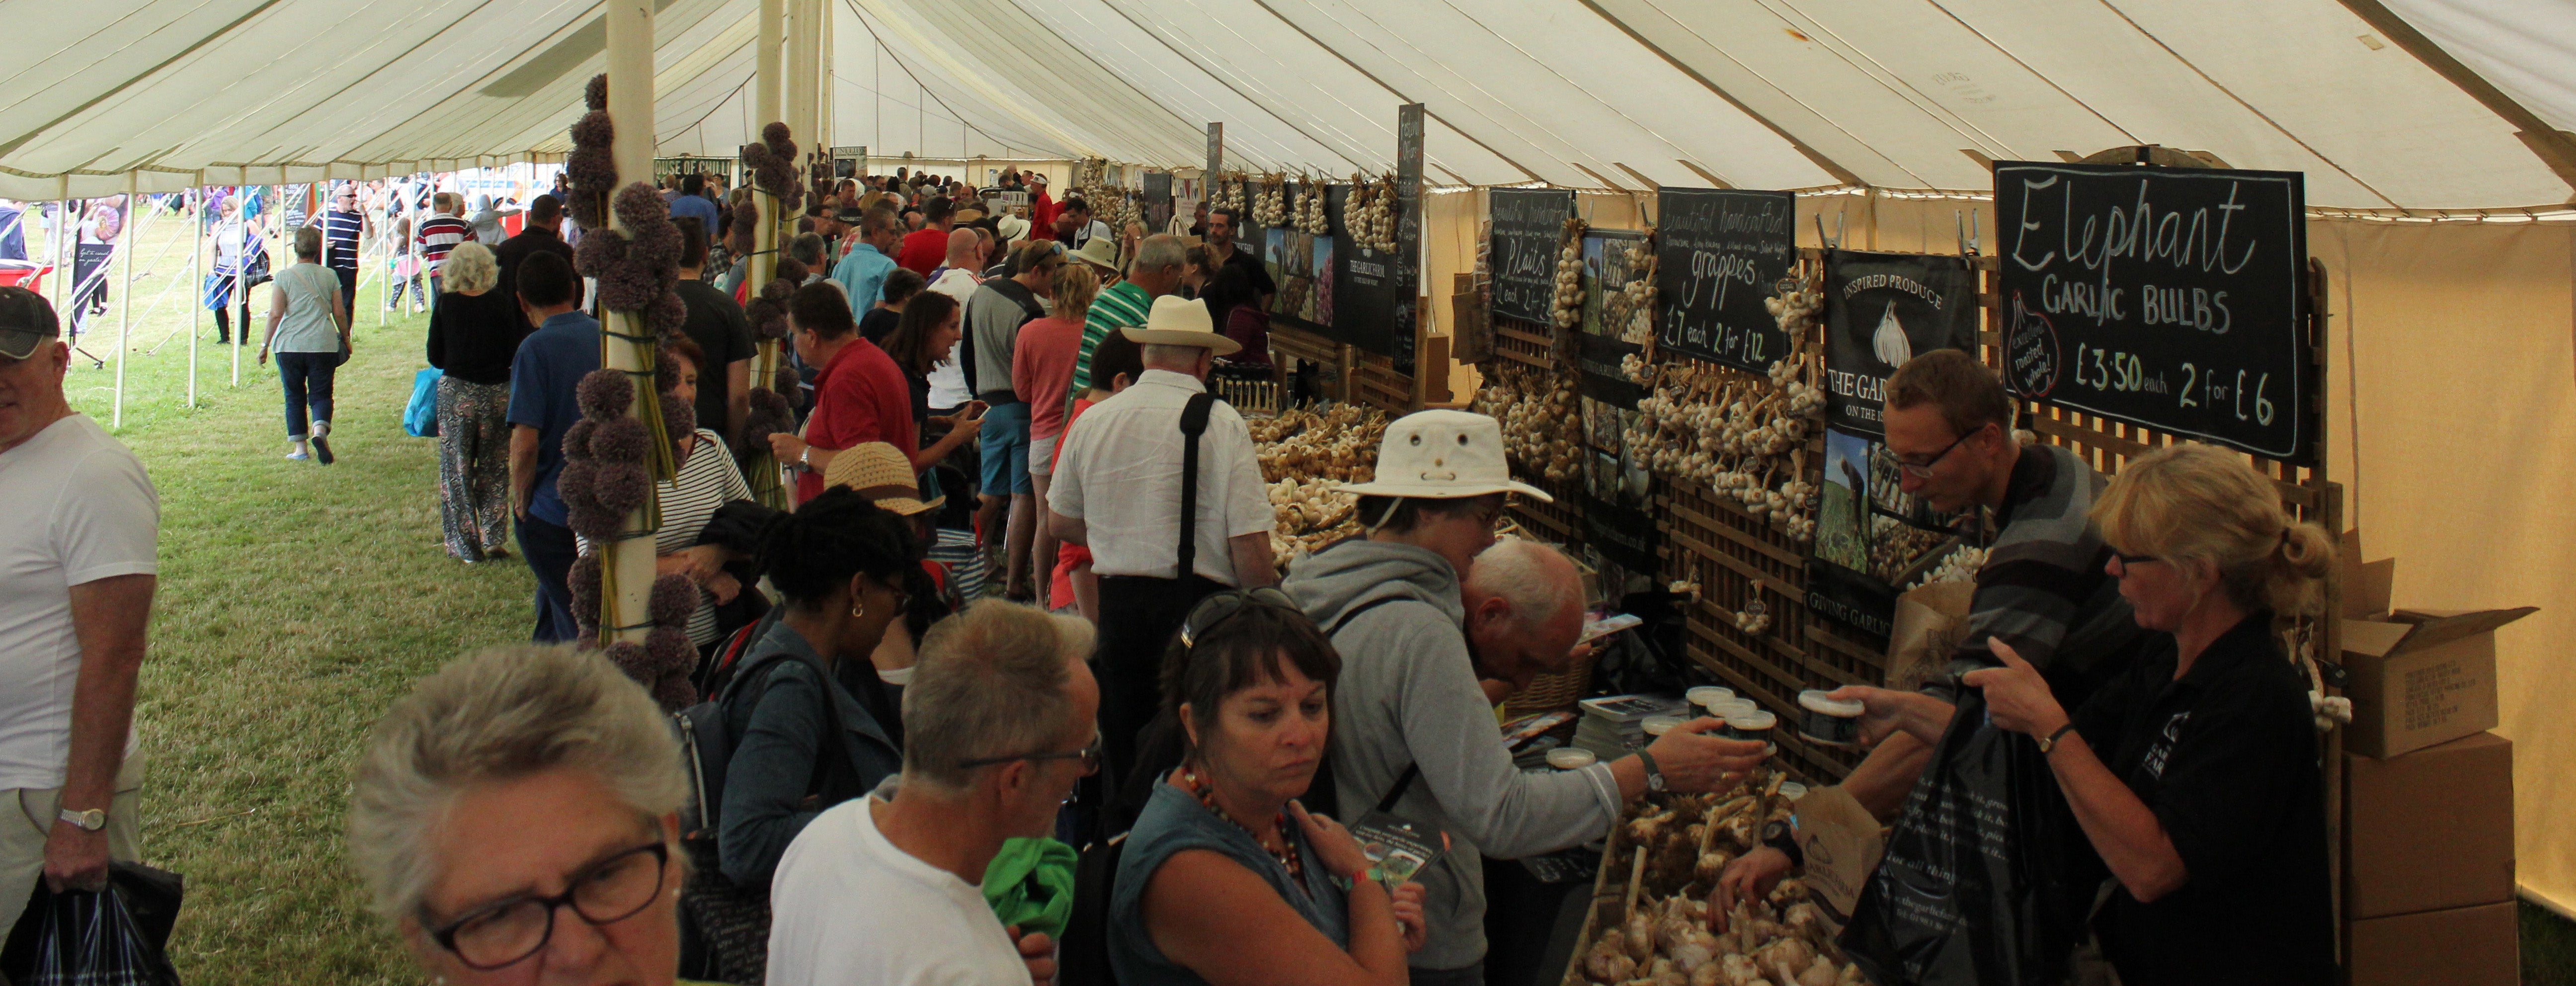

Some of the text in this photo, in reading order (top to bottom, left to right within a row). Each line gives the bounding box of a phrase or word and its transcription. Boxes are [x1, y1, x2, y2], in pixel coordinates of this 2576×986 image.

[654, 160, 731, 176] OUSE OF CHILLI
[1506, 238, 1545, 276] Plaits
[2013, 175, 2255, 326] Elephant
[1683, 250, 1755, 311] grappes
[1843, 274, 1942, 311] INSPIRED PRODUCE
[2043, 274, 2231, 334] GARLIC BULBS
[1665, 304, 1765, 364] £7 each 2 for £12
[2015, 343, 2043, 373] roasted
[2024, 356, 2051, 388] whole!
[1828, 368, 1888, 402] THE GAR
[2144, 372, 2168, 395] each
[2180, 363, 2197, 408] 2
[2205, 369, 2229, 409] for
[2236, 369, 2274, 426] £6
[1846, 405, 1858, 417] ON
[1860, 408, 1876, 421] THE
[1810, 592, 1891, 638] GIVING GARLIC
